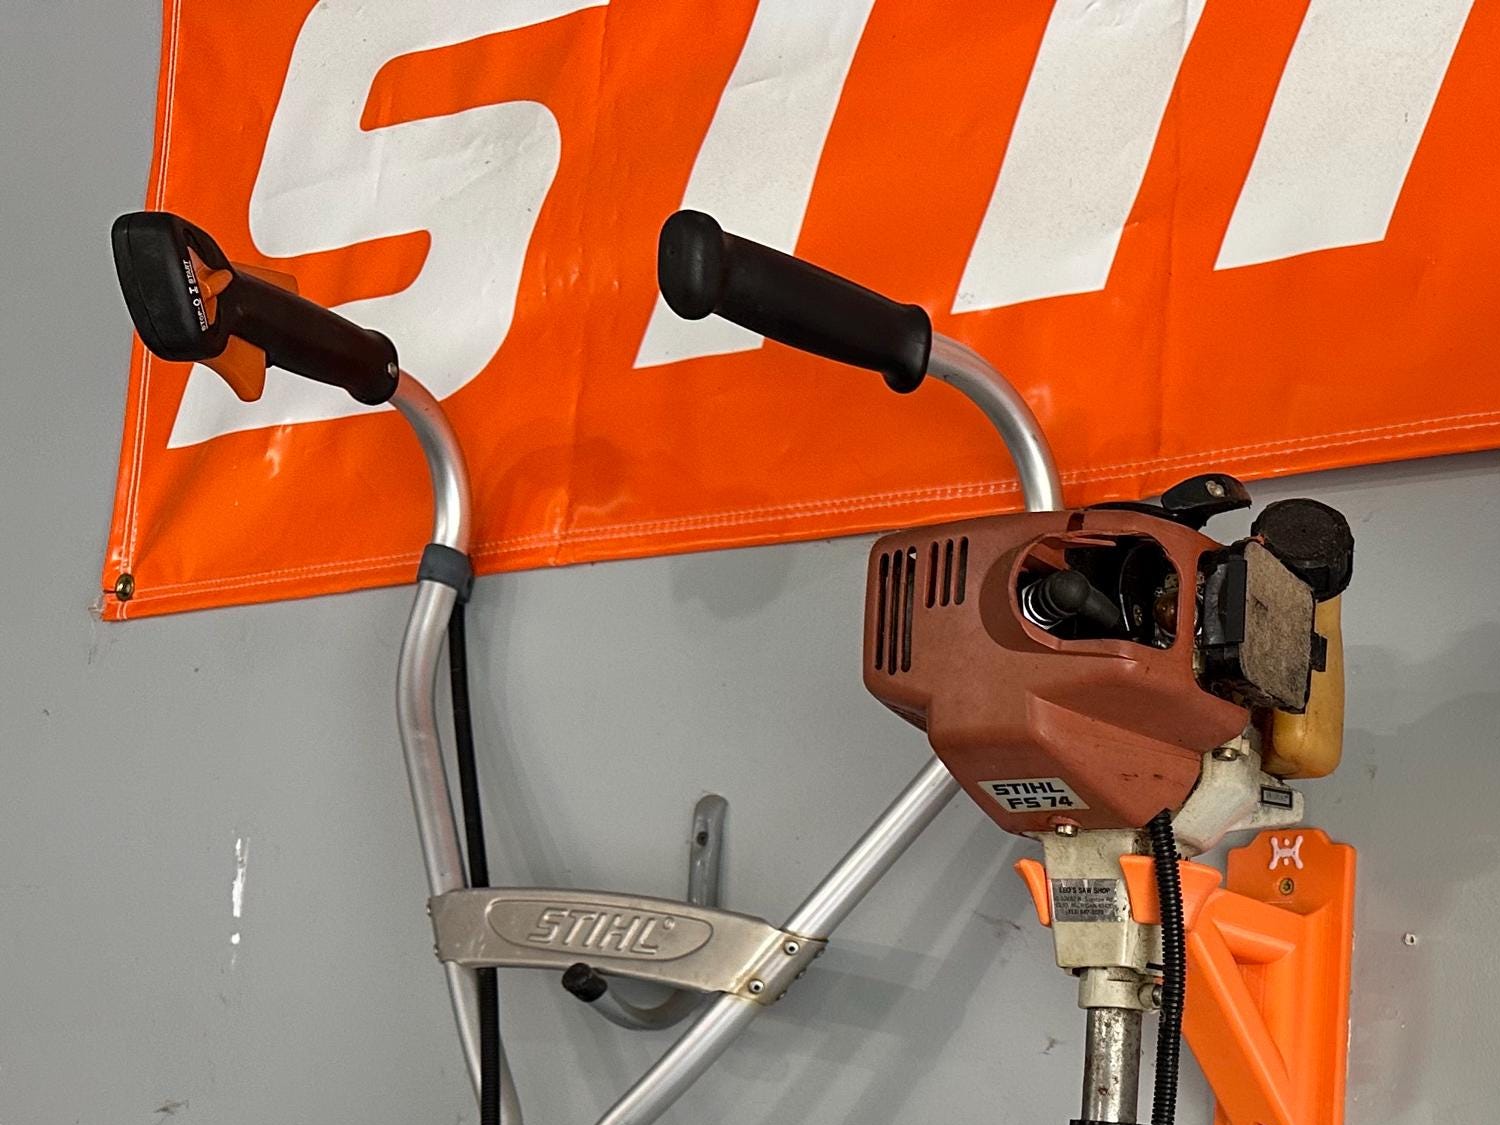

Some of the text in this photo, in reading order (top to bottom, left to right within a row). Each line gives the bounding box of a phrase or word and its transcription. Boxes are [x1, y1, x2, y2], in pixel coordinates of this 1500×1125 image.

[992, 782, 1065, 795] STIHL
[1006, 796, 1074, 809] FS 74
